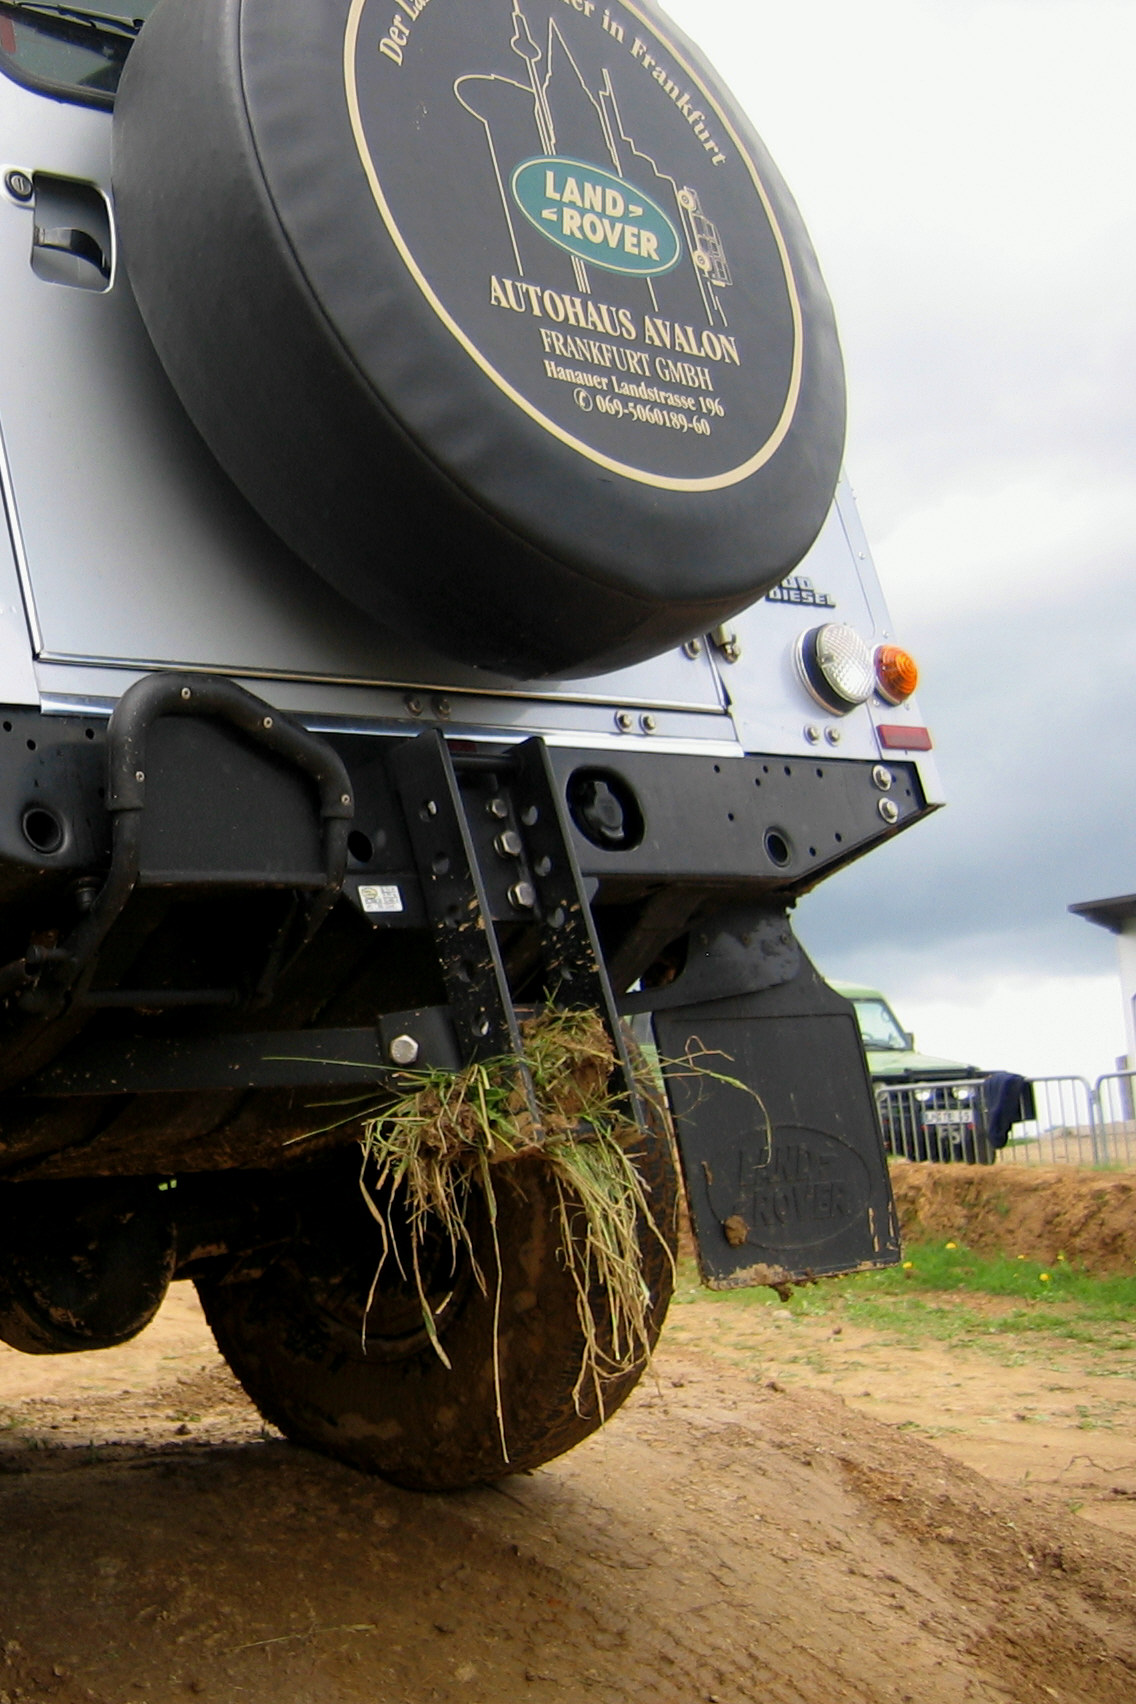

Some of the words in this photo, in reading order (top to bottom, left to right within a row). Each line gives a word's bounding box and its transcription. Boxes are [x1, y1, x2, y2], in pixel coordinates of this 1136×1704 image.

[379, 14, 411, 66] Der
[602, 9, 624, 43] in
[629, 37, 726, 166] Frankfurt
[545, 170, 625, 218] LAND
[562, 207, 660, 261] ROVER
[490, 275, 637, 341] AUTOHAUS
[644, 315, 741, 366] AVALON
[539, 328, 652, 377] FRANKFURT
[655, 357, 714, 391] GMBH
[543, 360, 608, 390] Hanauer
[613, 376, 696, 409] Landstrasse
[699, 397, 724, 417] 196
[596, 394, 711, 436] 069-5060189-60
[767, 586, 836, 608] DIESEL
